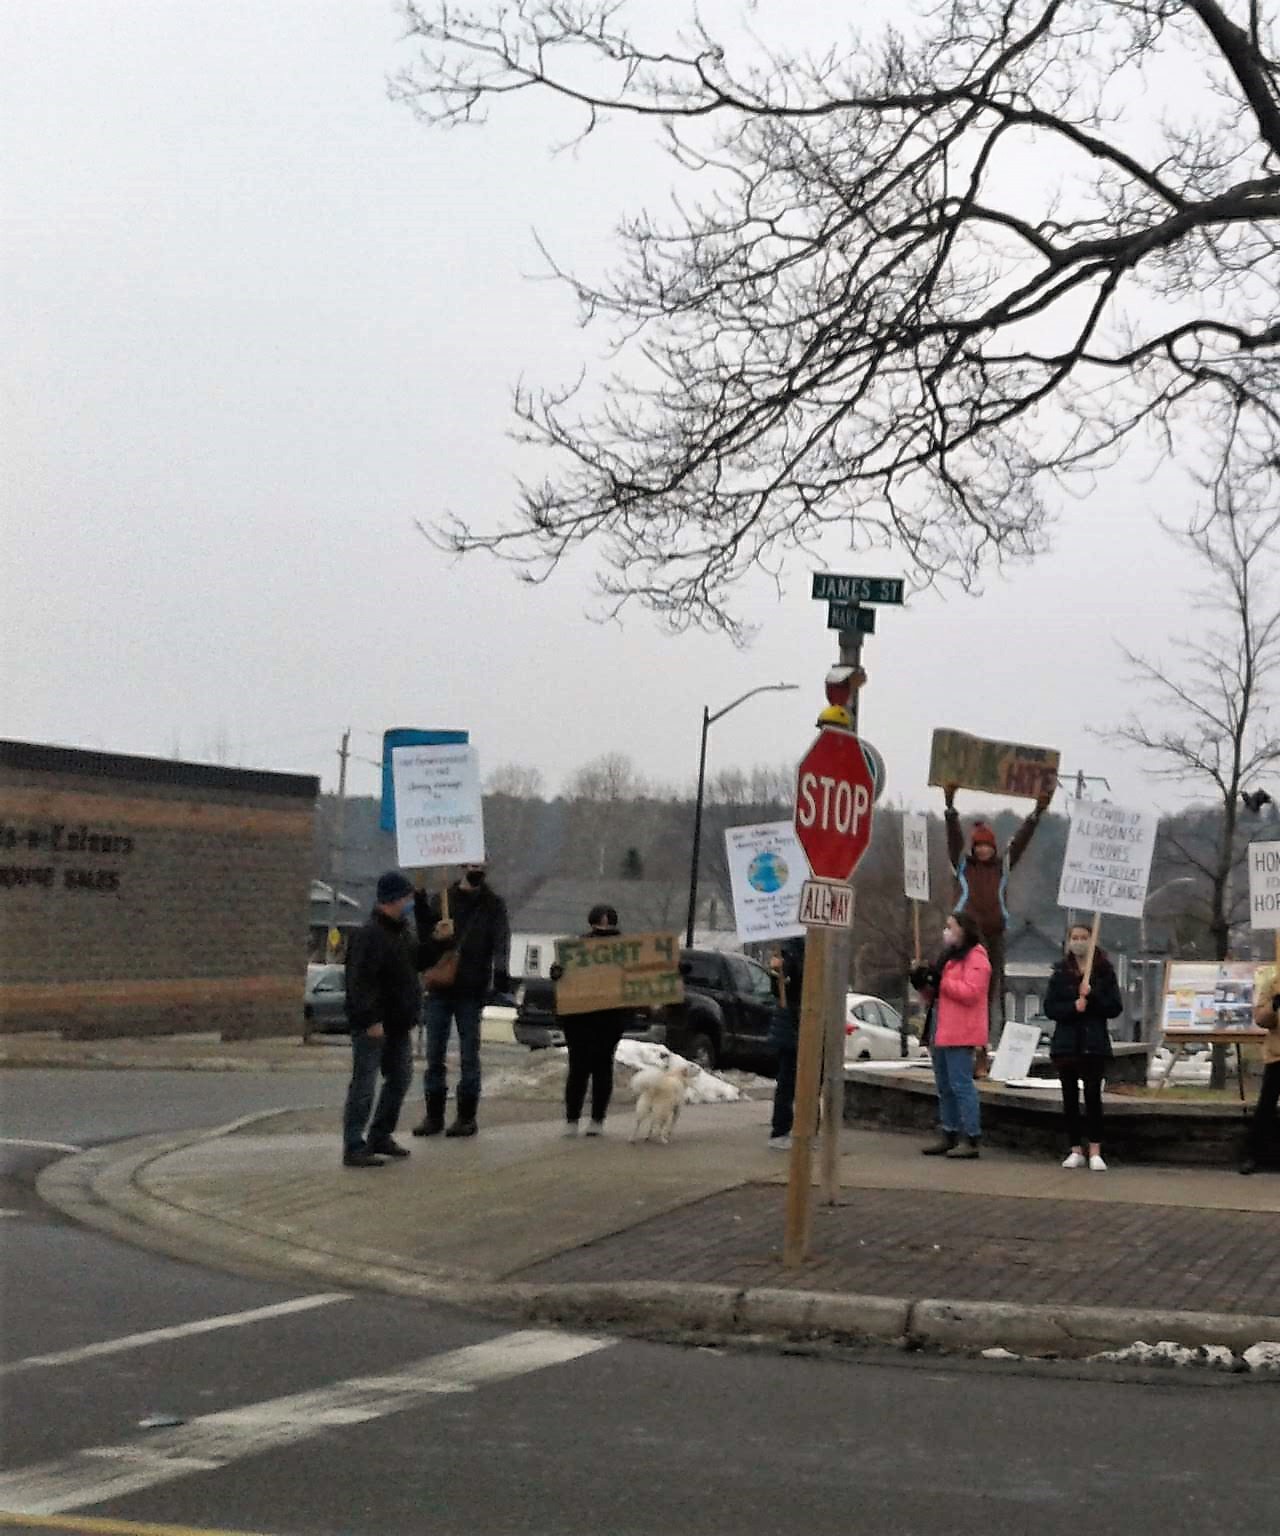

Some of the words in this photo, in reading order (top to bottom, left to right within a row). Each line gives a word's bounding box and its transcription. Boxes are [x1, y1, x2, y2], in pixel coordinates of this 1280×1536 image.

[818, 578, 870, 600] JAMES
[881, 581, 900, 601] ST
[800, 772, 869, 836] STOP
[558, 940, 643, 969] FIGHT
[655, 936, 673, 961] 4
